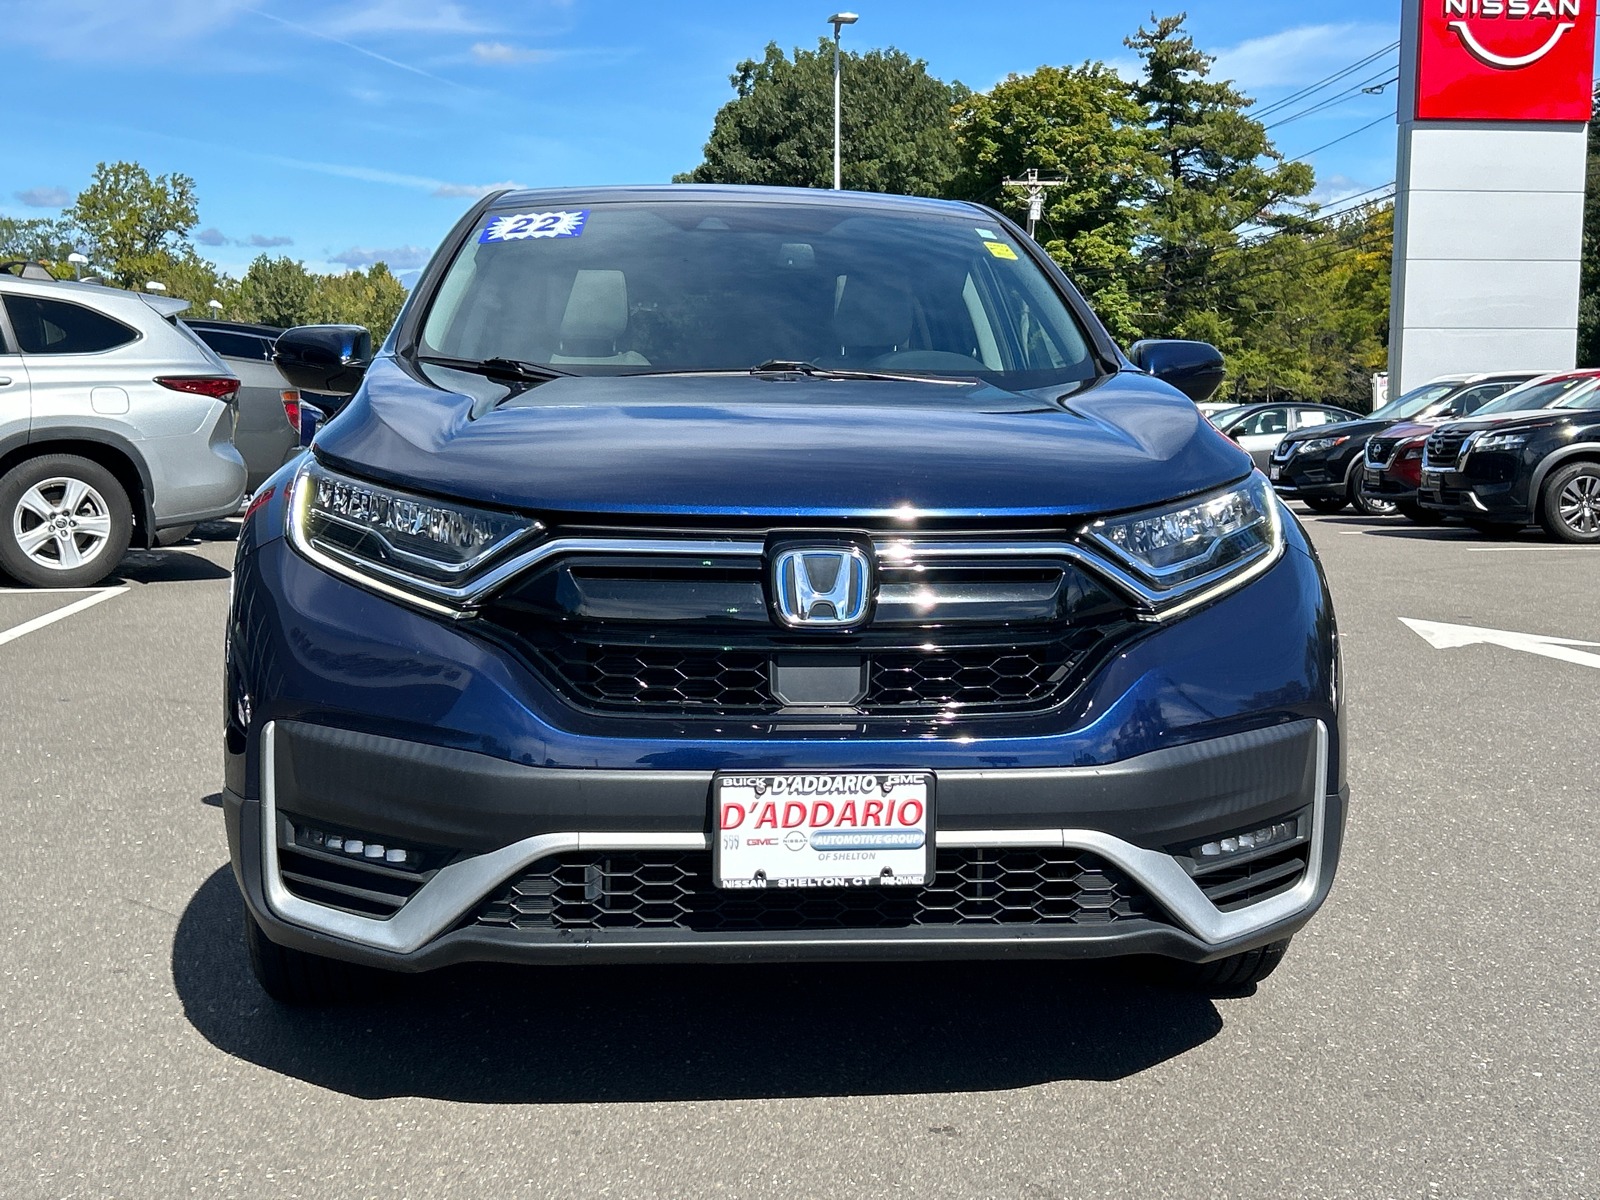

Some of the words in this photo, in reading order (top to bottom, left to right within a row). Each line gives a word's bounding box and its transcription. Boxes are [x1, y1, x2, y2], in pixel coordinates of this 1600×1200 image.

[1445, 0, 1579, 16] NISSAN
[723, 777, 766, 787] BUICK
[771, 775, 877, 794] D'ADDARIO
[887, 774, 925, 784] GMC
[720, 799, 923, 830] D'ADDARIO
[746, 838, 779, 846] GMC
[815, 834, 882, 846] AUTOMOTIVE
[883, 833, 920, 844] GROUP
[818, 853, 831, 861] OF
[833, 852, 876, 861] SHELTON
[723, 879, 767, 888] NISSAN
[778, 877, 849, 887] SHELTON,
[852, 877, 872, 886] CT
